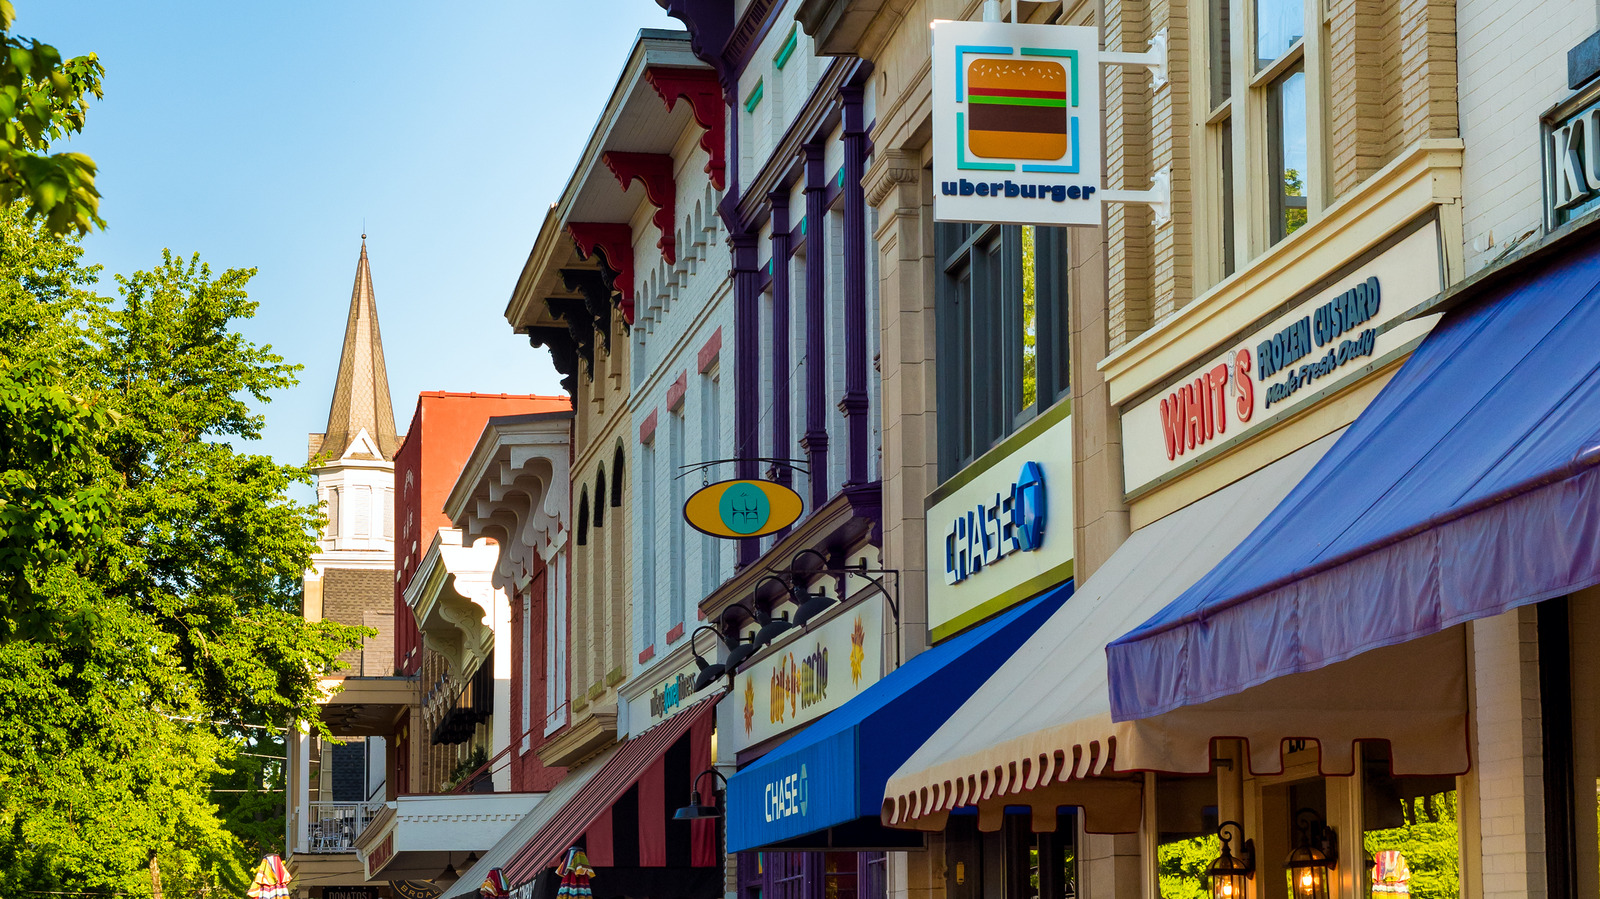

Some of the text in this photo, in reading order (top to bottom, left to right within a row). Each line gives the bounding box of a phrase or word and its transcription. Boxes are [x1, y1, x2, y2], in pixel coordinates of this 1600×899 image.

[941, 178, 1096, 202] uberburger
[1256, 276, 1381, 381] FROZEN CUSTARD
[1265, 327, 1376, 410] Made Fresh Daily
[944, 482, 1020, 587] CHASE
[765, 772, 799, 823] CHASE
